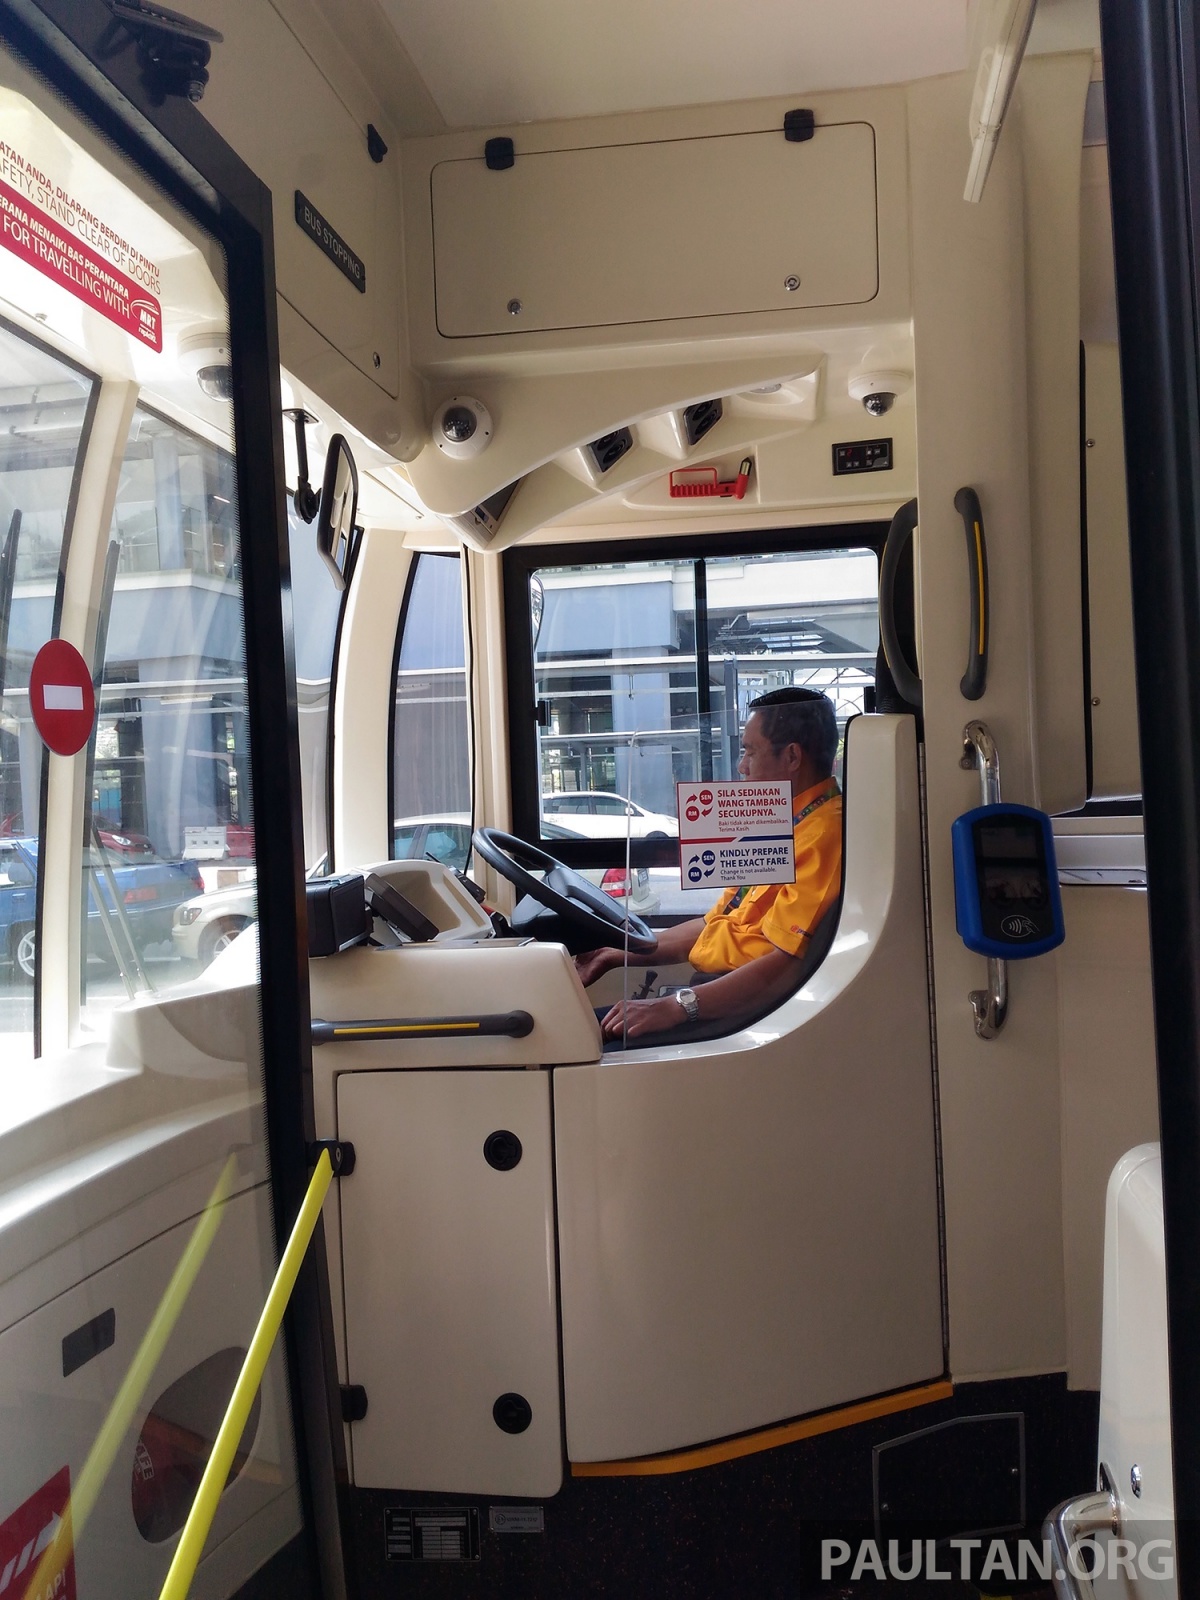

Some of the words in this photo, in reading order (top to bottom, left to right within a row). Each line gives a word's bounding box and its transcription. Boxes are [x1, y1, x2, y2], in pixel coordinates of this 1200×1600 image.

[0, 157, 34, 199] FETY,
[37, 186, 75, 227] STAND
[77, 219, 111, 257] CLEAR
[113, 244, 126, 267] OF
[128, 258, 161, 295] DOORS
[25, 162, 54, 195] ANDA,
[56, 185, 99, 229] DILARANG
[100, 224, 130, 253] BERDIRI
[130, 246, 139, 260] DI
[139, 252, 160, 278] PINTU
[304, 206, 322, 236] BUS
[323, 227, 360, 279] STOPPING
[3, 213, 31, 249] FOR
[32, 234, 102, 299] TRAVELLING
[103, 287, 130, 319] WITH
[29, 217, 67, 253] MENAIKI
[68, 243, 84, 266] BAS
[84, 256, 129, 299] PERANTARA
[139, 308, 156, 330] MRT
[717, 789, 736, 798] SILA
[738, 788, 780, 797] SEDIAKAN
[718, 799, 744, 808] WANG
[745, 798, 787, 807] TAMBANG
[718, 808, 776, 818] SECUKUPNYA.
[720, 848, 750, 858] KINDLY
[752, 847, 788, 856] PREPARE
[720, 860, 737, 868] THE
[739, 858, 764, 867] EXACT
[766, 857, 789, 866] FARE.
